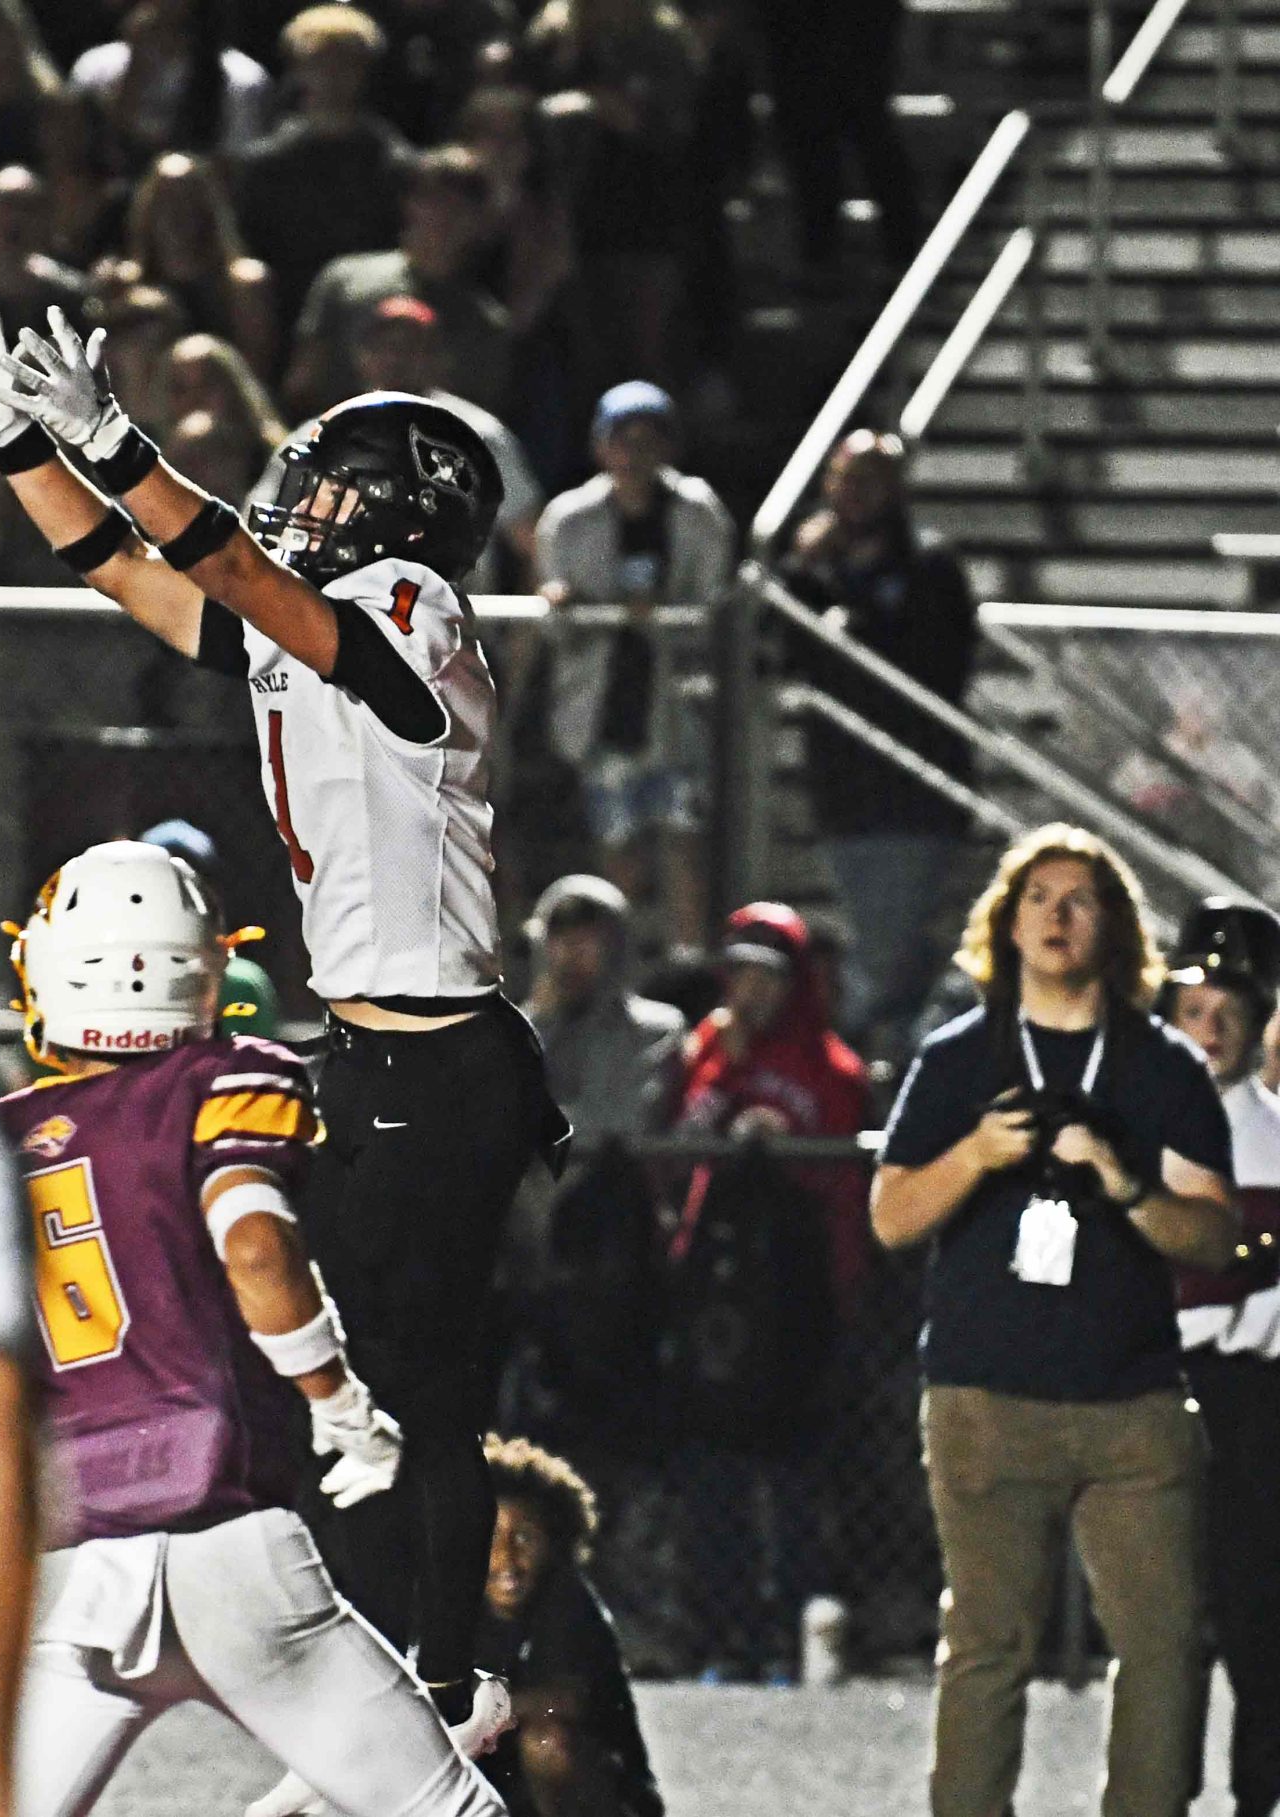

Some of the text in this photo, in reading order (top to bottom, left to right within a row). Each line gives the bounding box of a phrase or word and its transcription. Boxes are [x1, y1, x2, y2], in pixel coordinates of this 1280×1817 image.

[390, 577, 422, 636] 1
[249, 672, 289, 694] RYLE
[268, 709, 315, 885] 1
[131, 953, 146, 972] 6
[25, 1156, 132, 1373] 6
